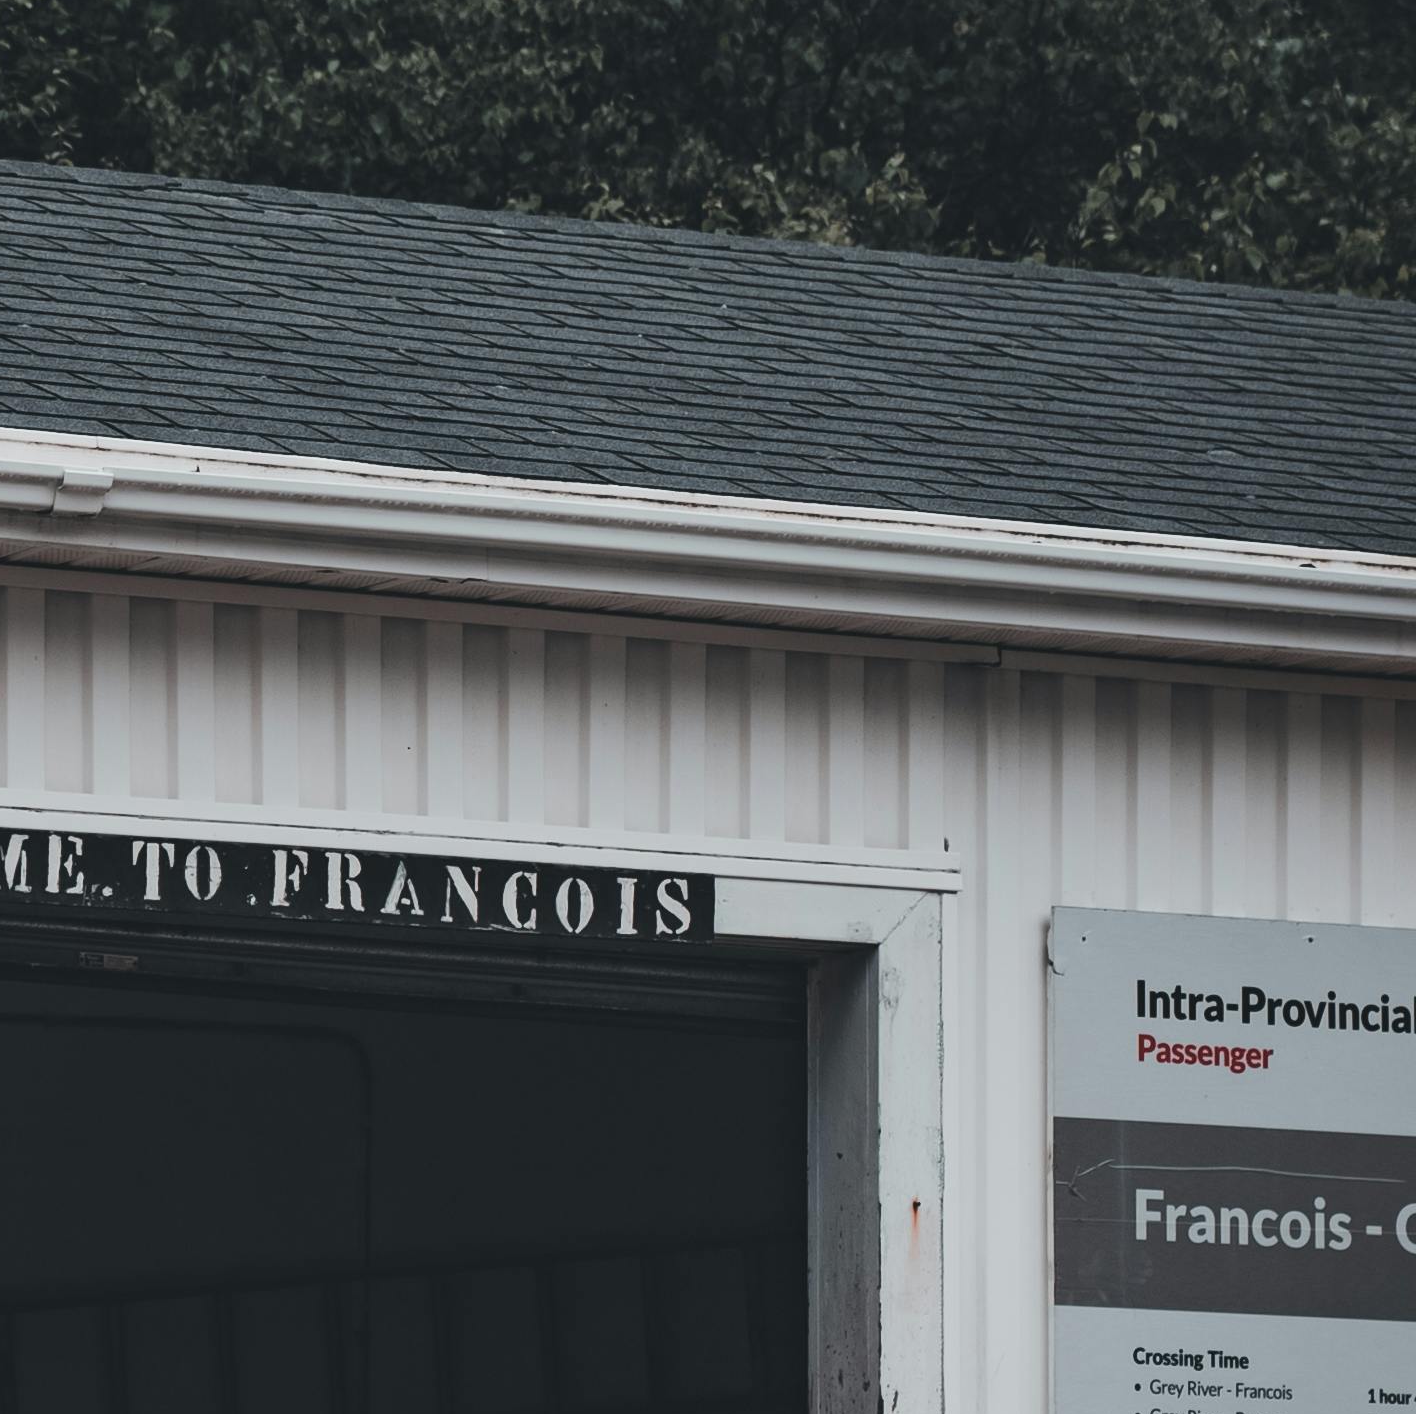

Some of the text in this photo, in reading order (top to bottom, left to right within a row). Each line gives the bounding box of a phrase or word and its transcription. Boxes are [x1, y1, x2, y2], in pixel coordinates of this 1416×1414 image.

[132, 840, 223, 902] TO
[270, 849, 692, 936] FRANCOIS
[1136, 979, 1416, 1034] Intra-Provincia
[1138, 1034, 1274, 1074] Passenger
[1135, 1188, 1353, 1251] Francois
[1133, 1347, 1250, 1371] Crossing Time
[1149, 1379, 1184, 1399] Grey
[1187, 1381, 1223, 1397] River
[1235, 1383, 1293, 1401] Francois
[1368, 1388, 1412, 1405] 1 hour
